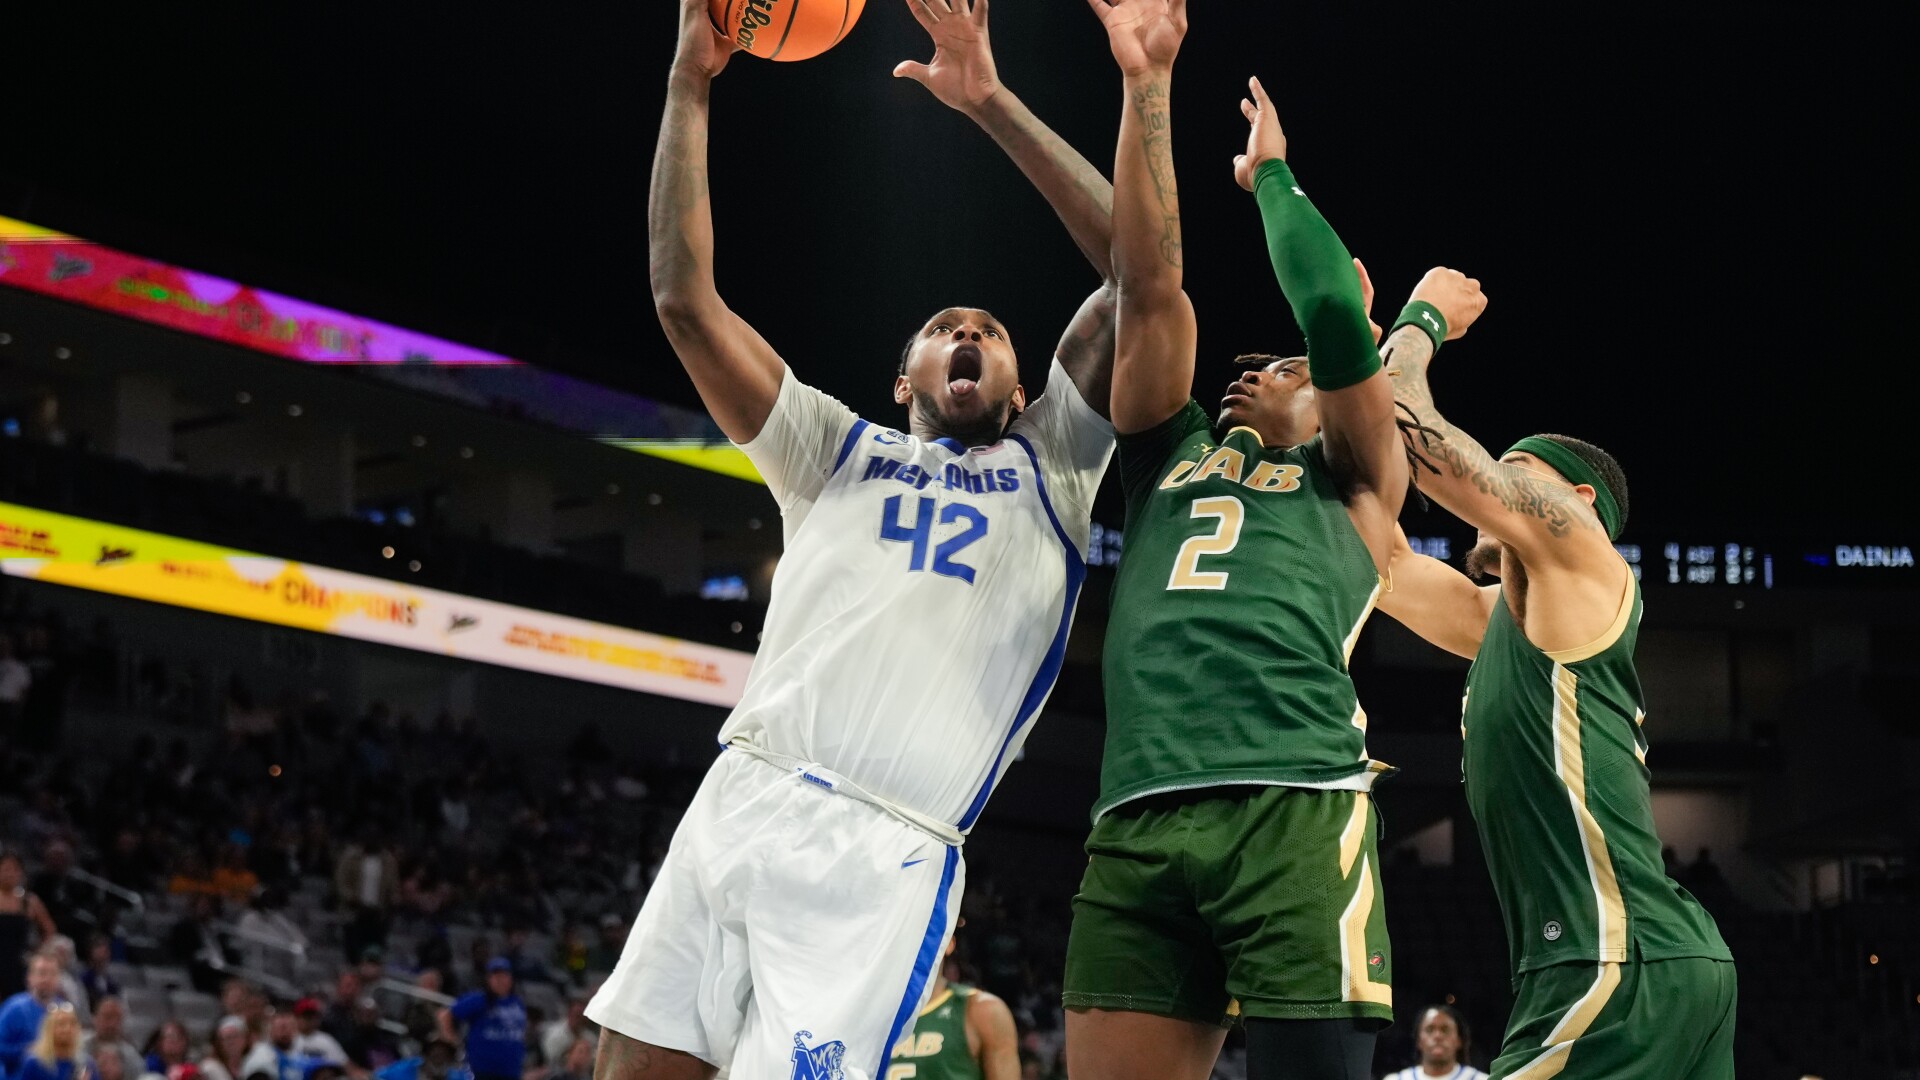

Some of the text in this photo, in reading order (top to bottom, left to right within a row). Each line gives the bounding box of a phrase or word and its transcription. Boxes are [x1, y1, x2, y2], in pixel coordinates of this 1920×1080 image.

[737, 0, 778, 50] ilson
[1159, 446, 1304, 492] UAB
[879, 493, 989, 586] 42
[1166, 495, 1245, 591] 2
[1835, 545, 1914, 567] DAINJA
